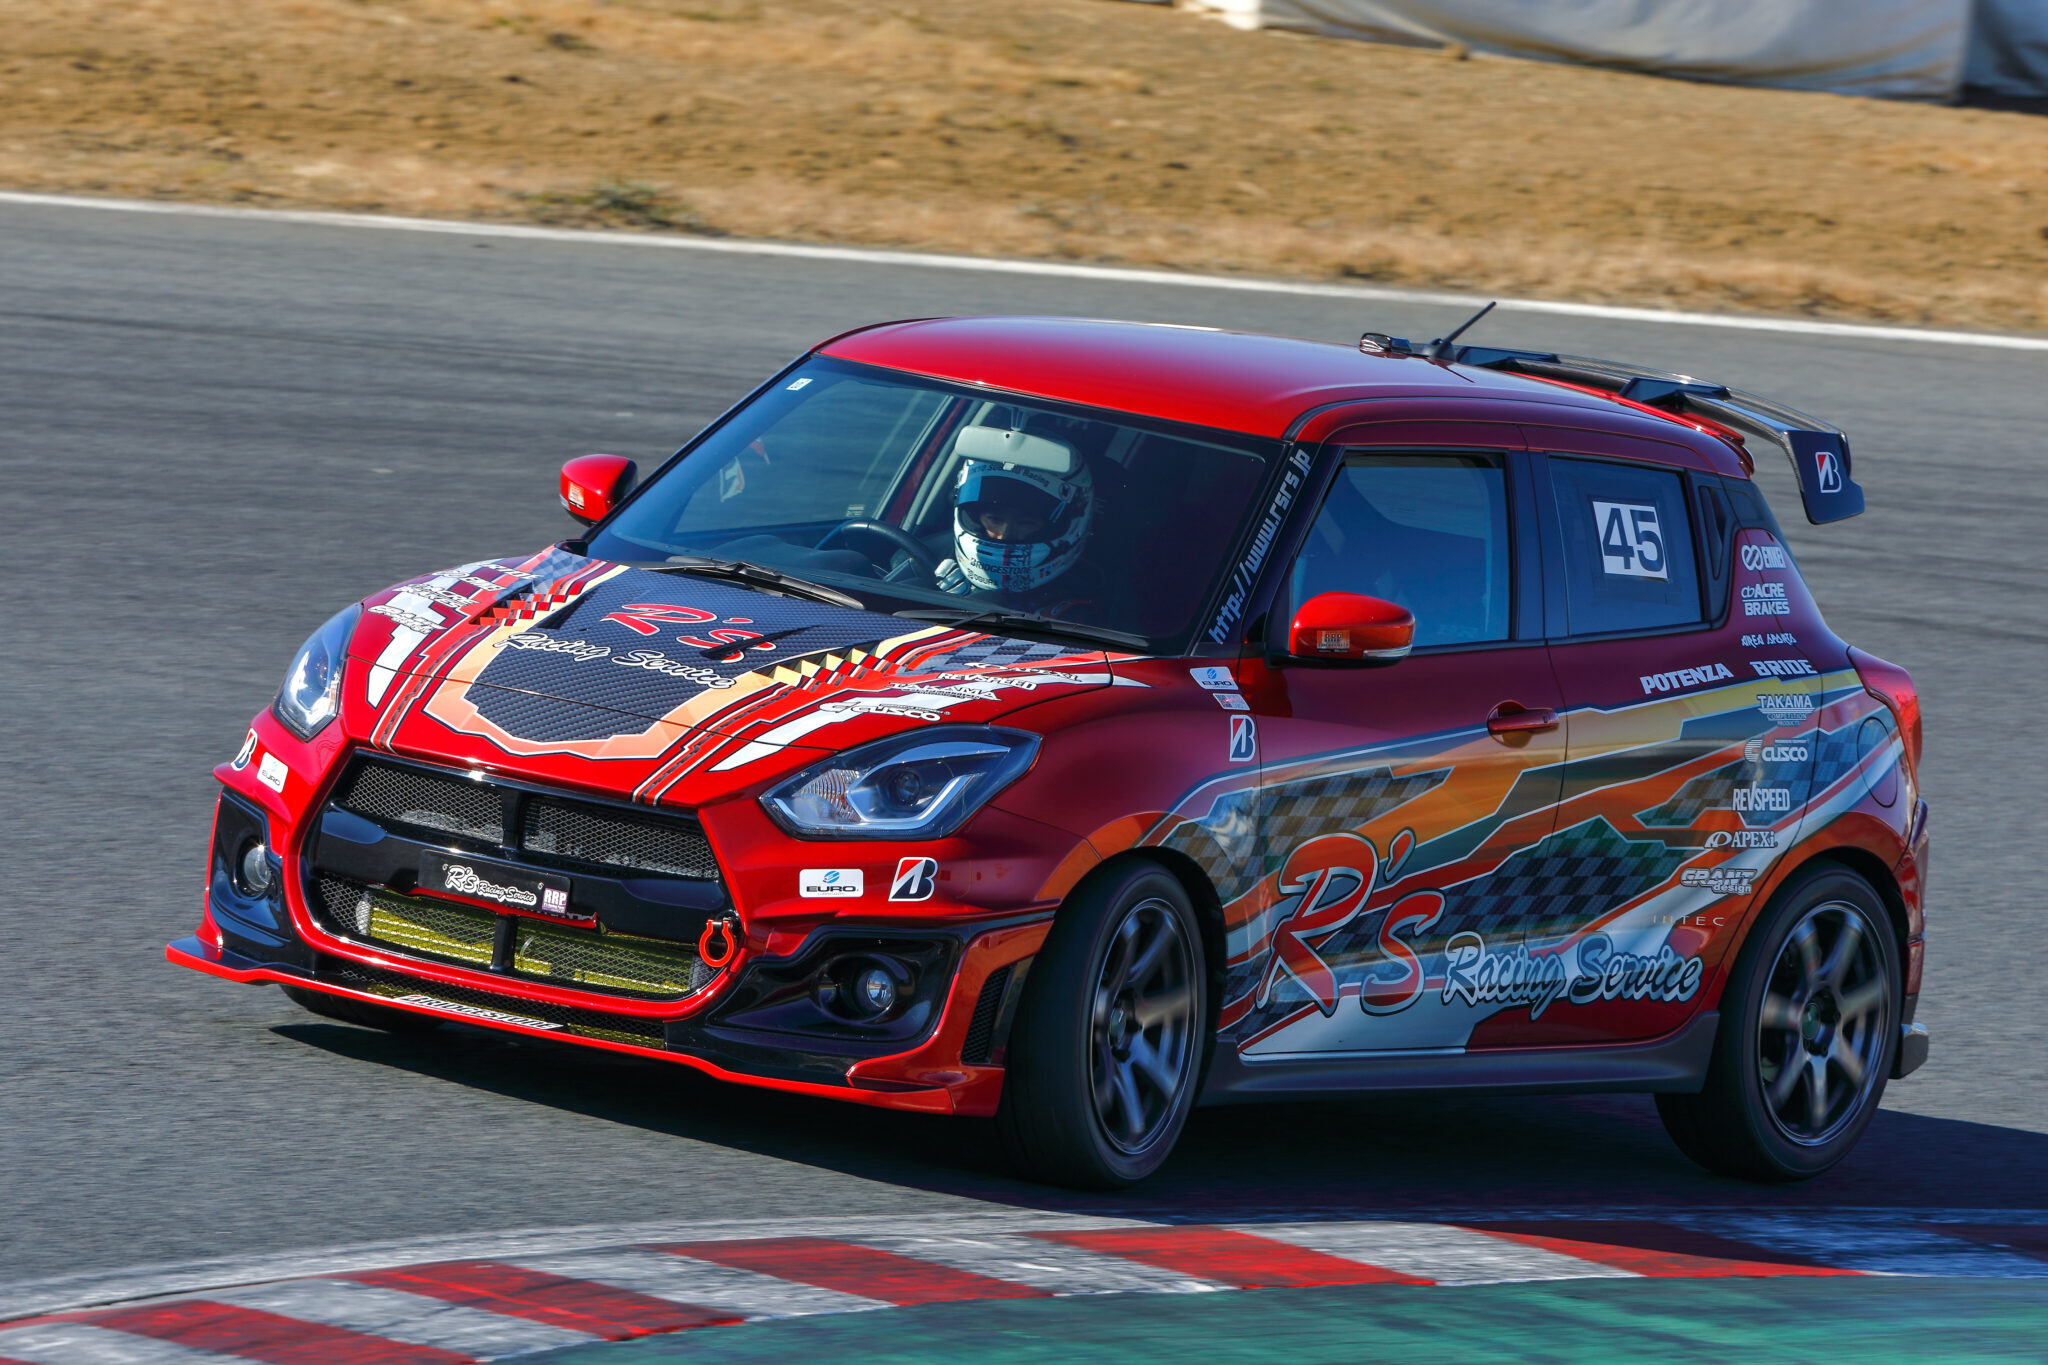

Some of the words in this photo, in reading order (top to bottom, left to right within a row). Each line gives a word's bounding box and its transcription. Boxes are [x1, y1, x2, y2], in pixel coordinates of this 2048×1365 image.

[1602, 508, 1664, 572] 45
[971, 557, 1032, 576] BRIDGESTONE
[1744, 601, 1790, 616] BRAKES
[493, 632, 611, 662] Racing
[611, 649, 737, 689] Service
[1750, 659, 1818, 677] BRIDE
[936, 671, 1038, 692] REVSPEED
[1640, 663, 1734, 695] POTENZA
[1757, 695, 1814, 708] TAKAMA
[1761, 747, 1808, 761] CUSCO
[1732, 781, 1790, 811] REVSPEED
[1681, 868, 1757, 886] GRANT
[477, 880, 506, 901] Racing
[505, 886, 538, 906] Service
[543, 889, 567, 906] RRP
[1713, 883, 1752, 895] design
[1442, 931, 1565, 1021] Racing
[1568, 933, 1703, 1002] Service
[403, 995, 557, 1030] BRIDGESTONE
